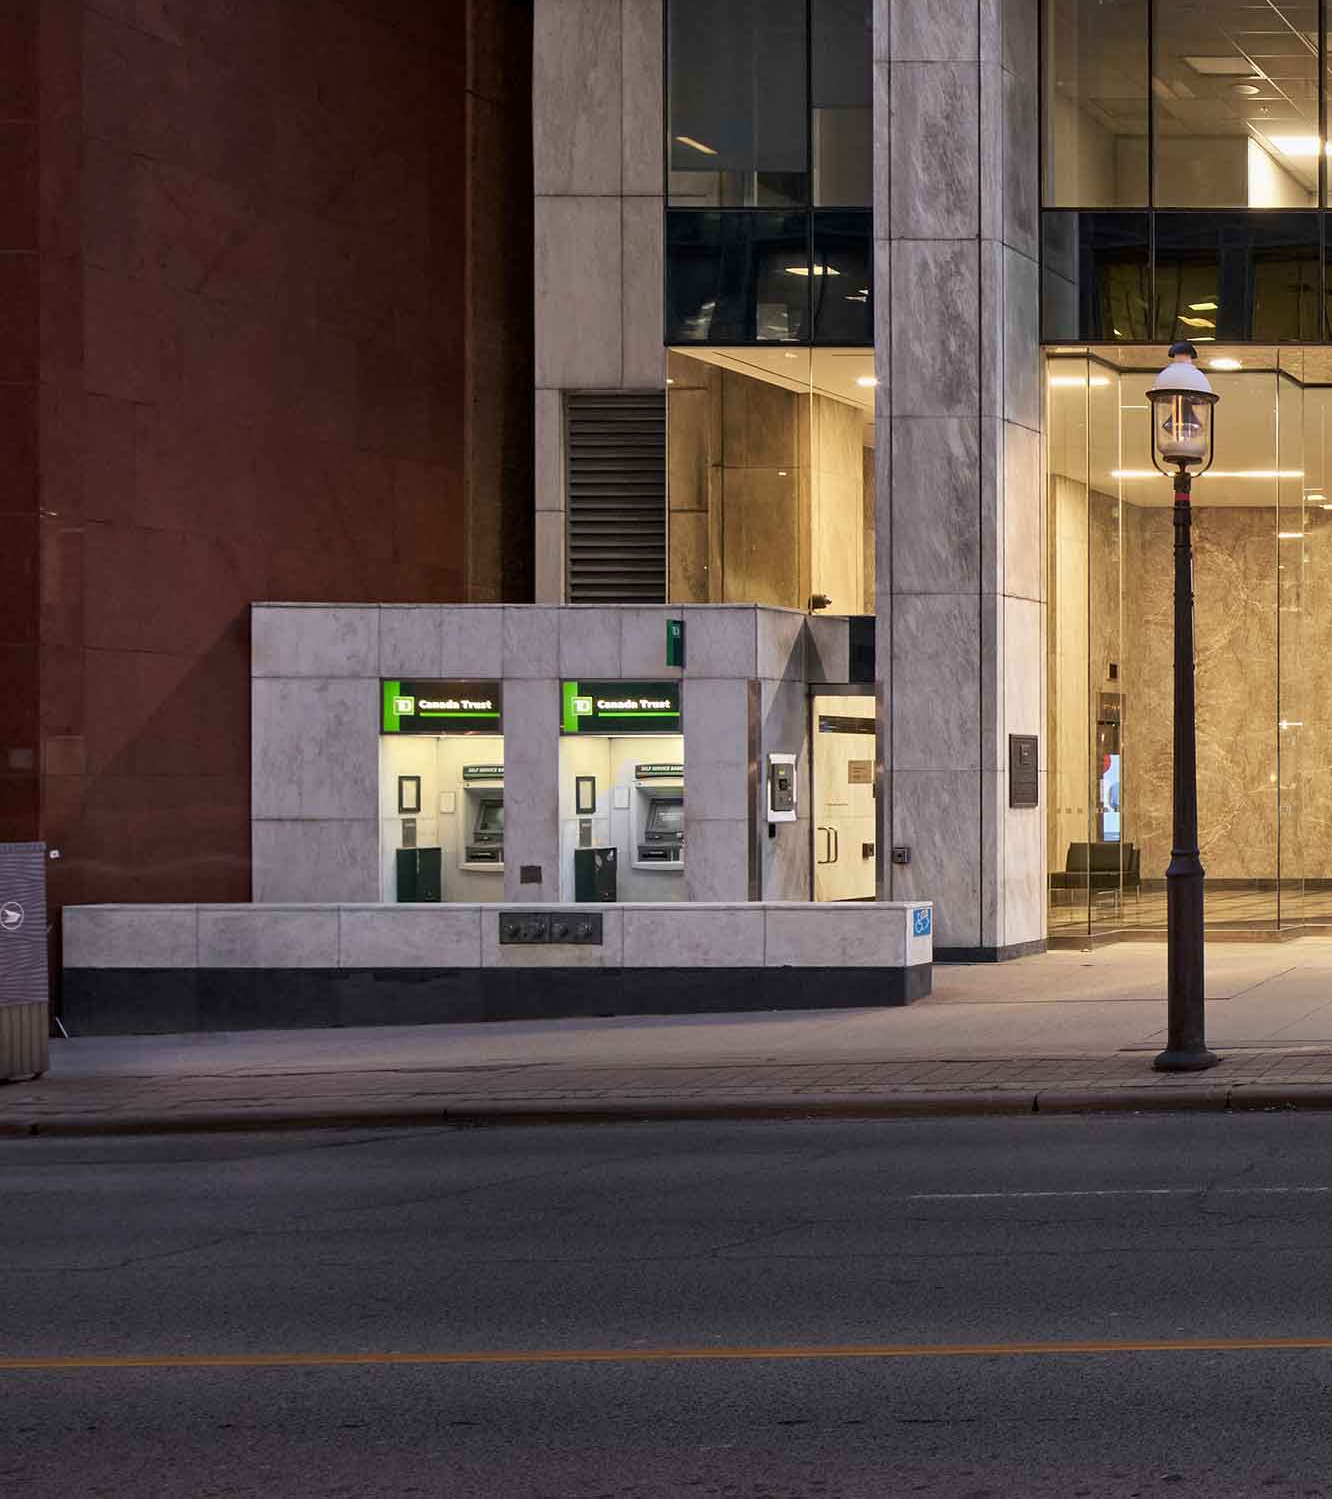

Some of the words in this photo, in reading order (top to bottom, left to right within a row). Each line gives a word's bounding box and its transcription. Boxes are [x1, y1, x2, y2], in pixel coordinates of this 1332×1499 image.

[418, 699, 460, 710] Canada
[460, 700, 493, 710] Trust
[596, 699, 639, 709] Canada
[639, 699, 671, 709] Trust
